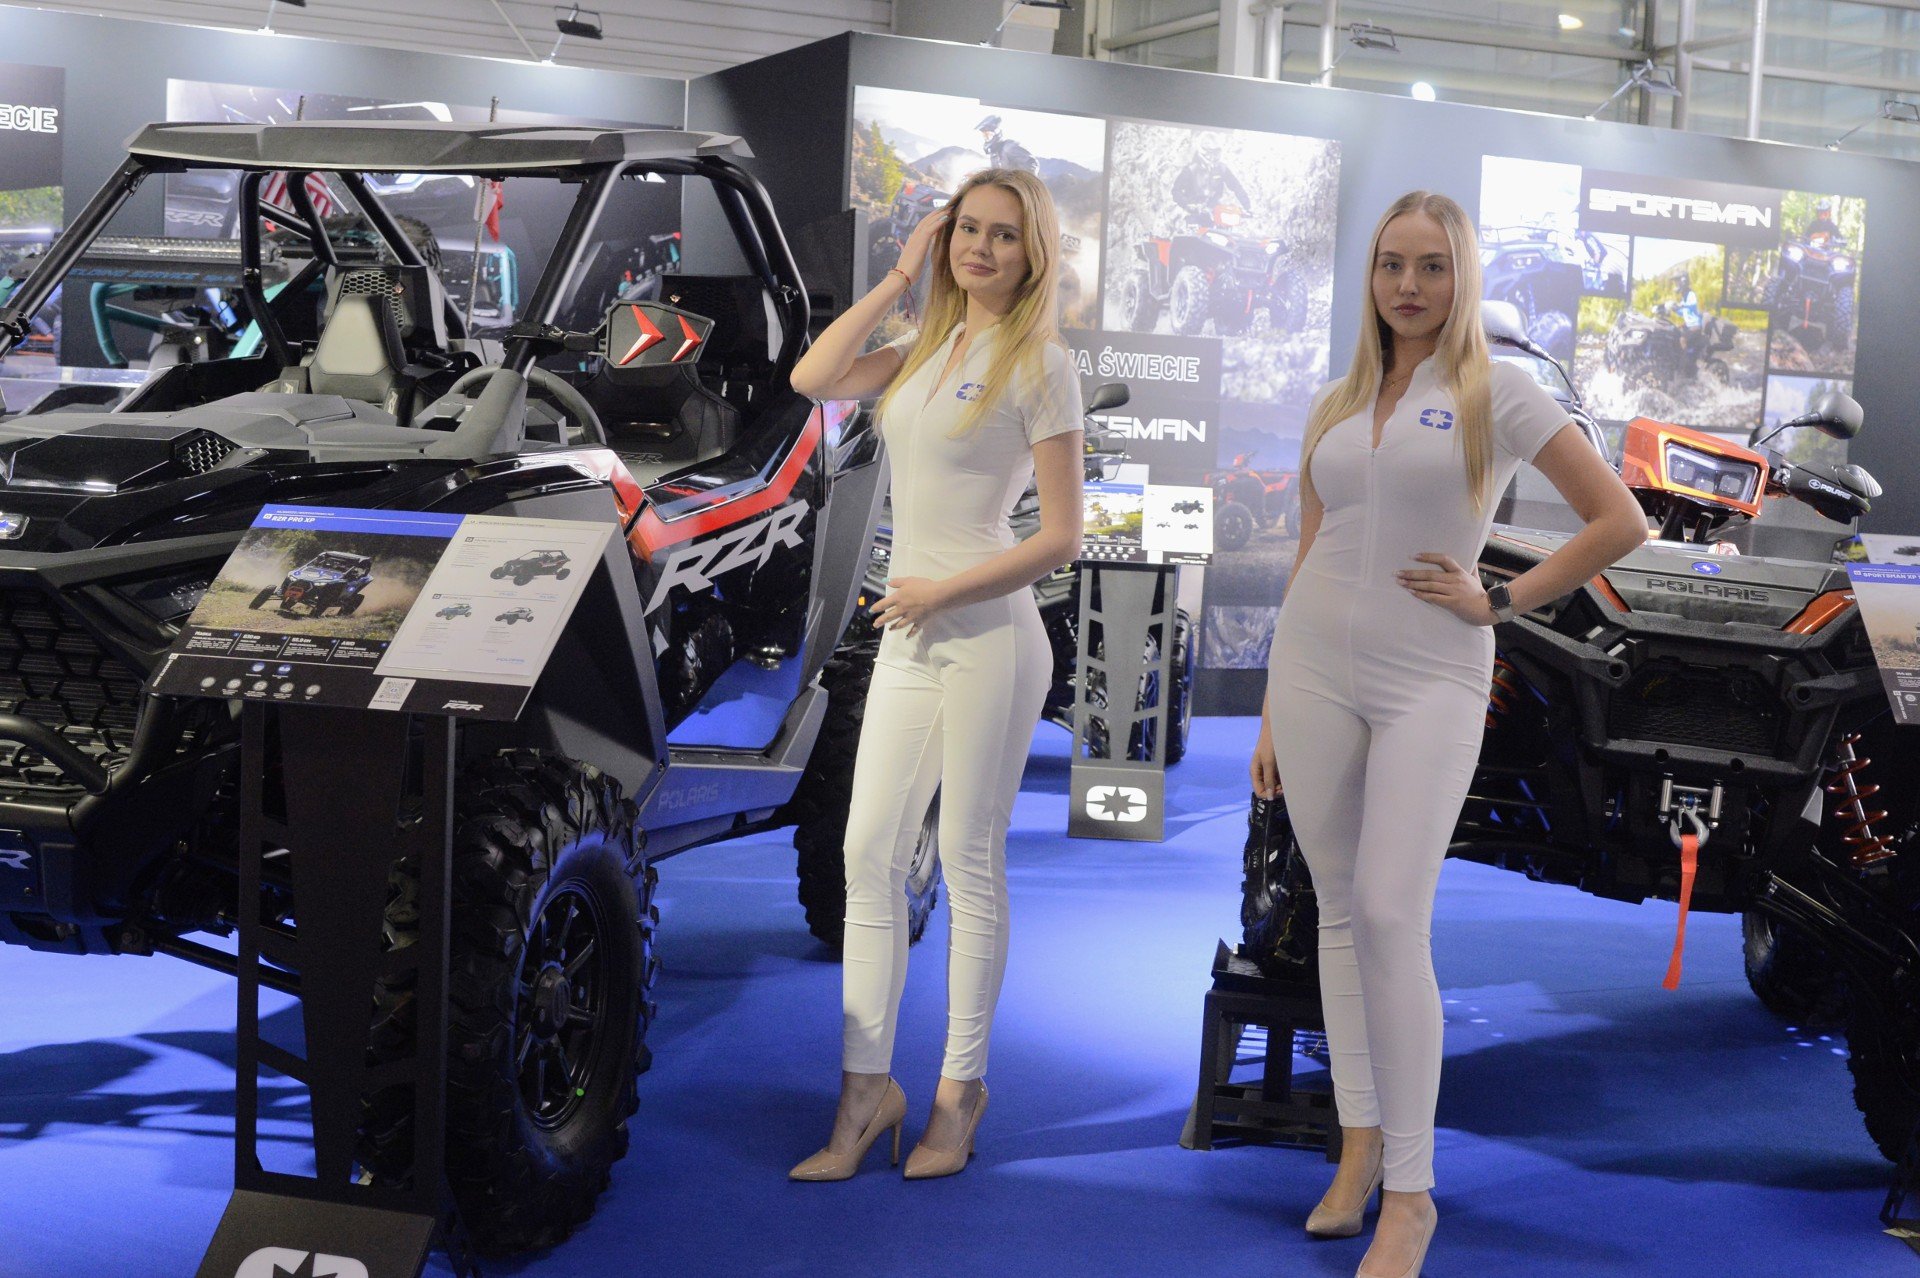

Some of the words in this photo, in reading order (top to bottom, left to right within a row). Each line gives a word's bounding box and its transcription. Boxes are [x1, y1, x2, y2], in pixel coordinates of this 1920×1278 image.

[1589, 188, 1772, 228] SPORTSMAN
[1098, 345, 1200, 382] ŚWIECIE
[1820, 483, 1852, 501] POLARIS
[643, 499, 810, 618] RZR
[1646, 578, 1769, 602] POLARIS
[658, 782, 719, 812] POLARIS
